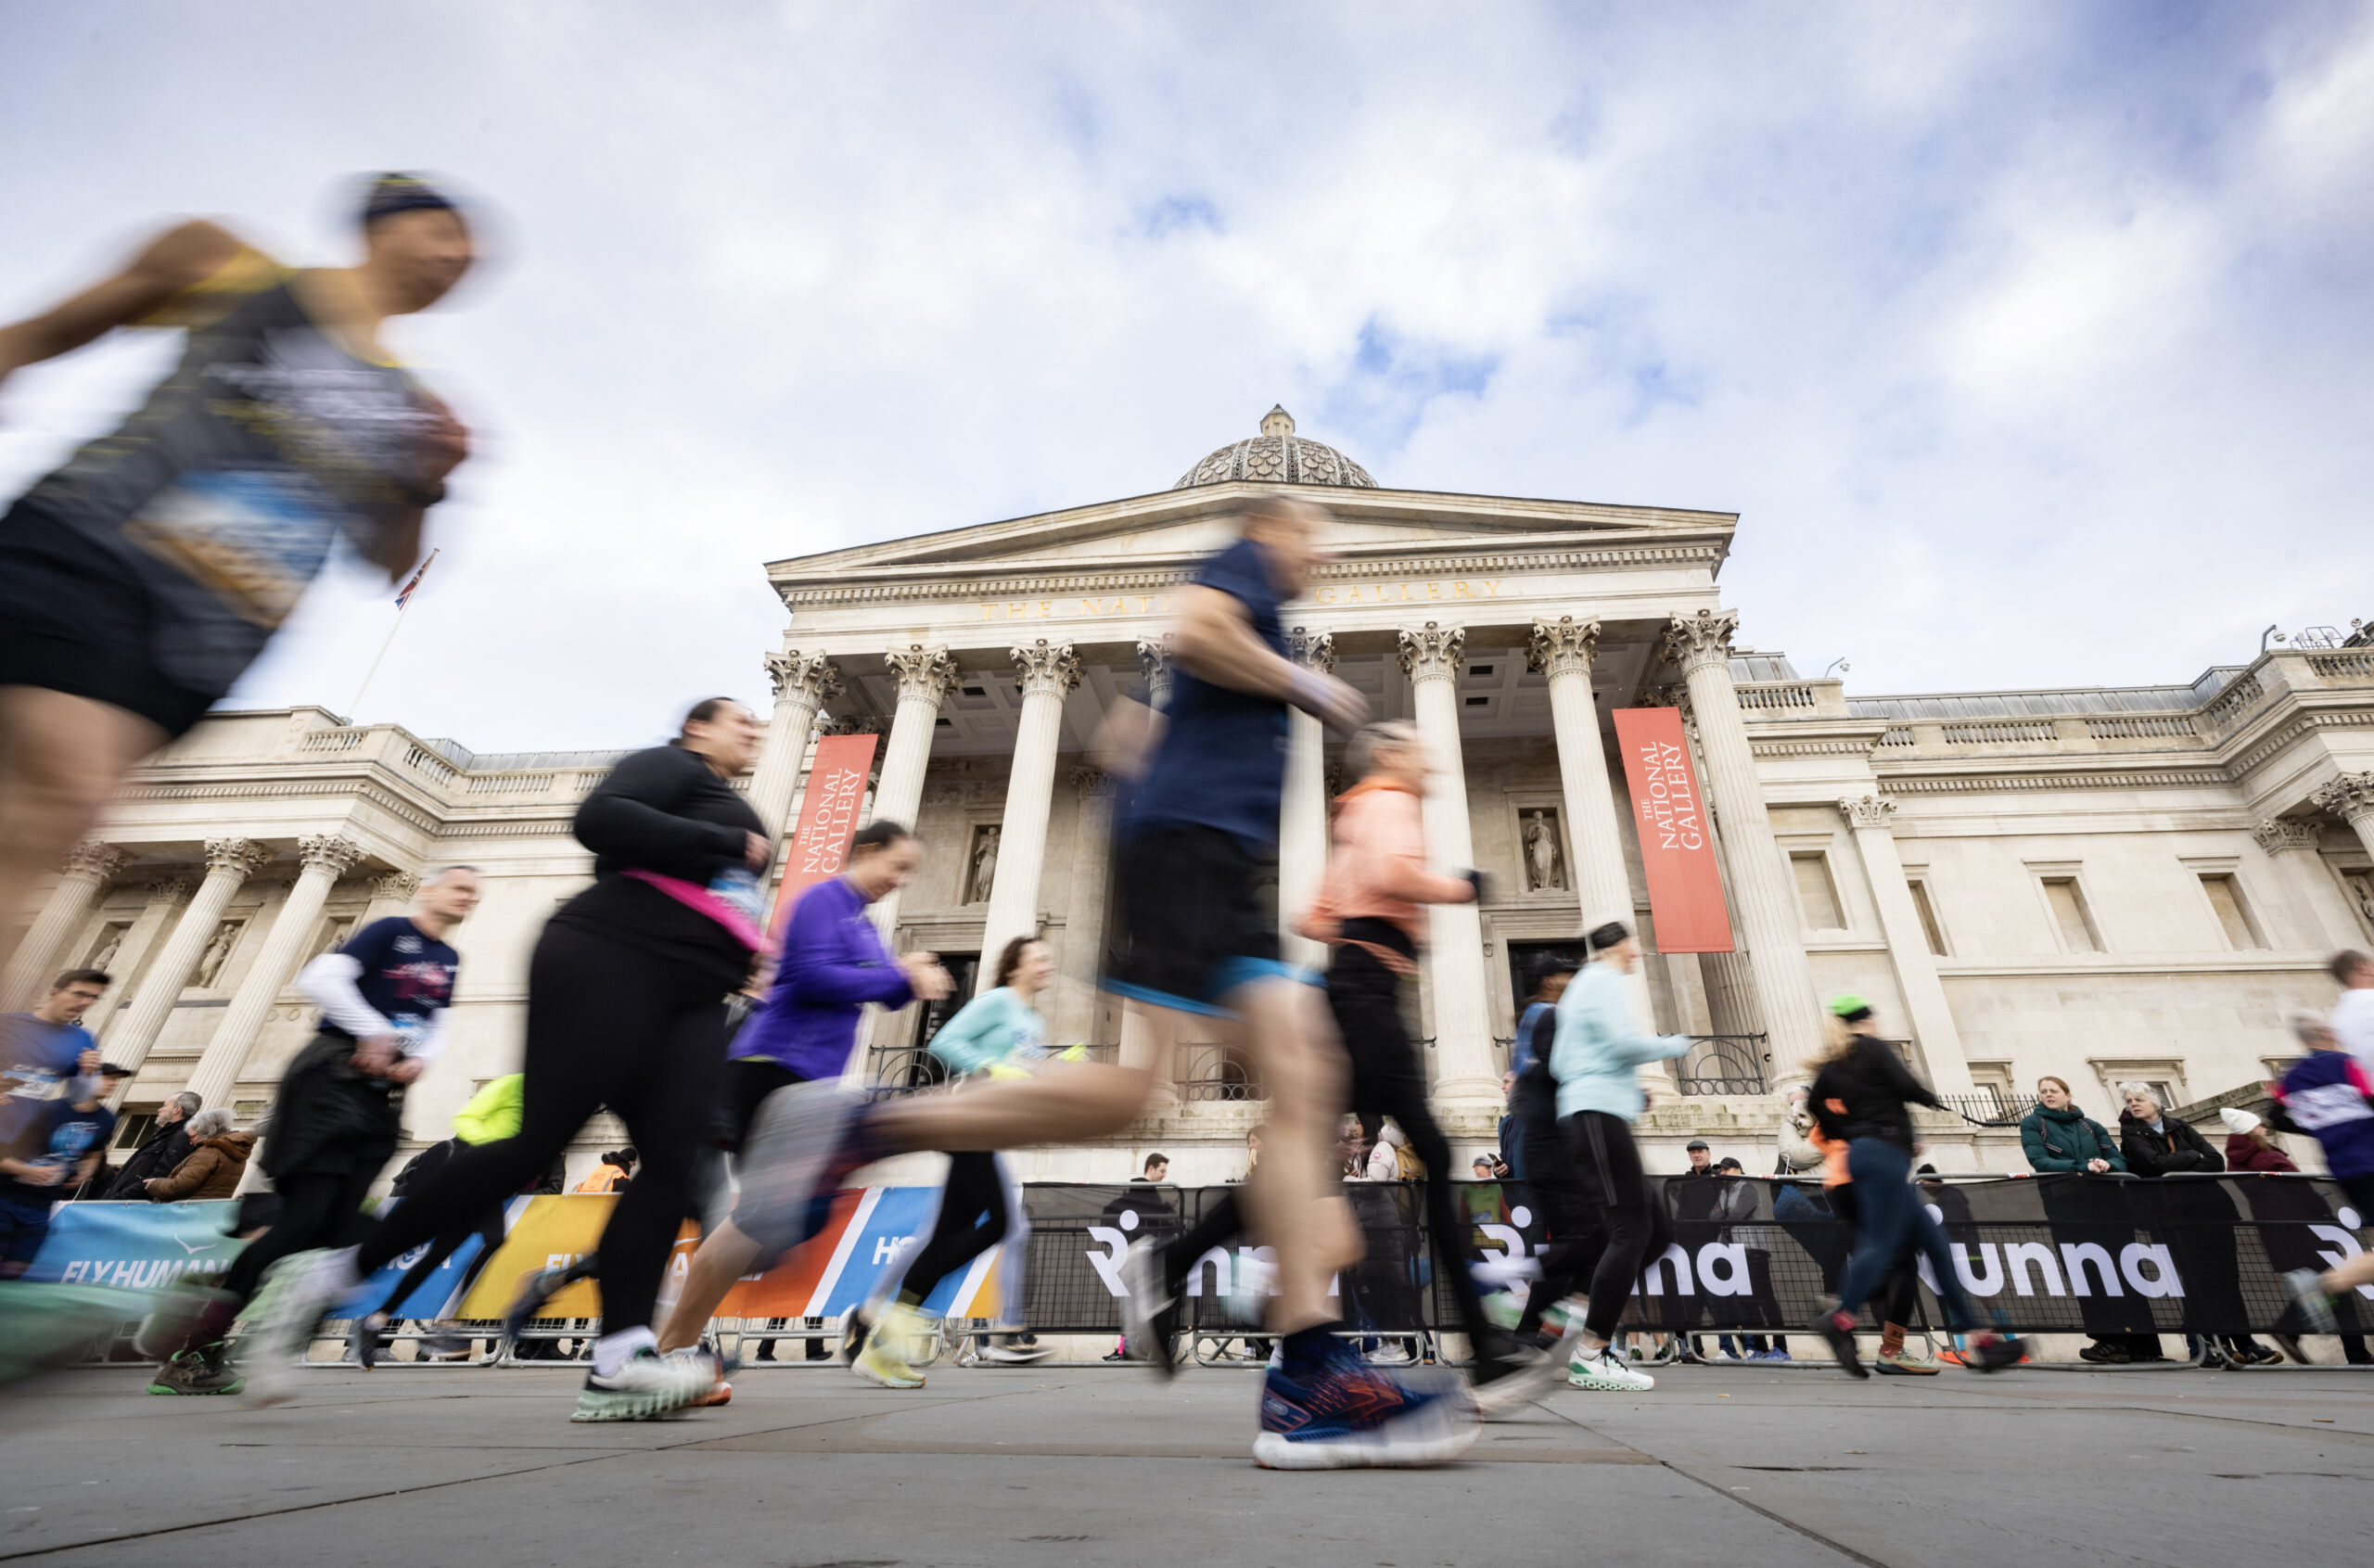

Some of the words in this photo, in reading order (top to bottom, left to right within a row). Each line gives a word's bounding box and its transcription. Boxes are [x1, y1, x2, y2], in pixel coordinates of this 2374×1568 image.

[979, 601, 1053, 620] THE
[1081, 596, 1172, 616] NATI
[1315, 580, 1501, 604] GALLERY
[801, 769, 842, 873] NATIONAL
[822, 768, 861, 873] GALLERY
[1640, 742, 1679, 849] NATIONAL
[1640, 798, 1653, 821] THE
[1660, 742, 1703, 850] GALLERY
[798, 824, 811, 846] THE
[60, 1260, 114, 1284] FLY
